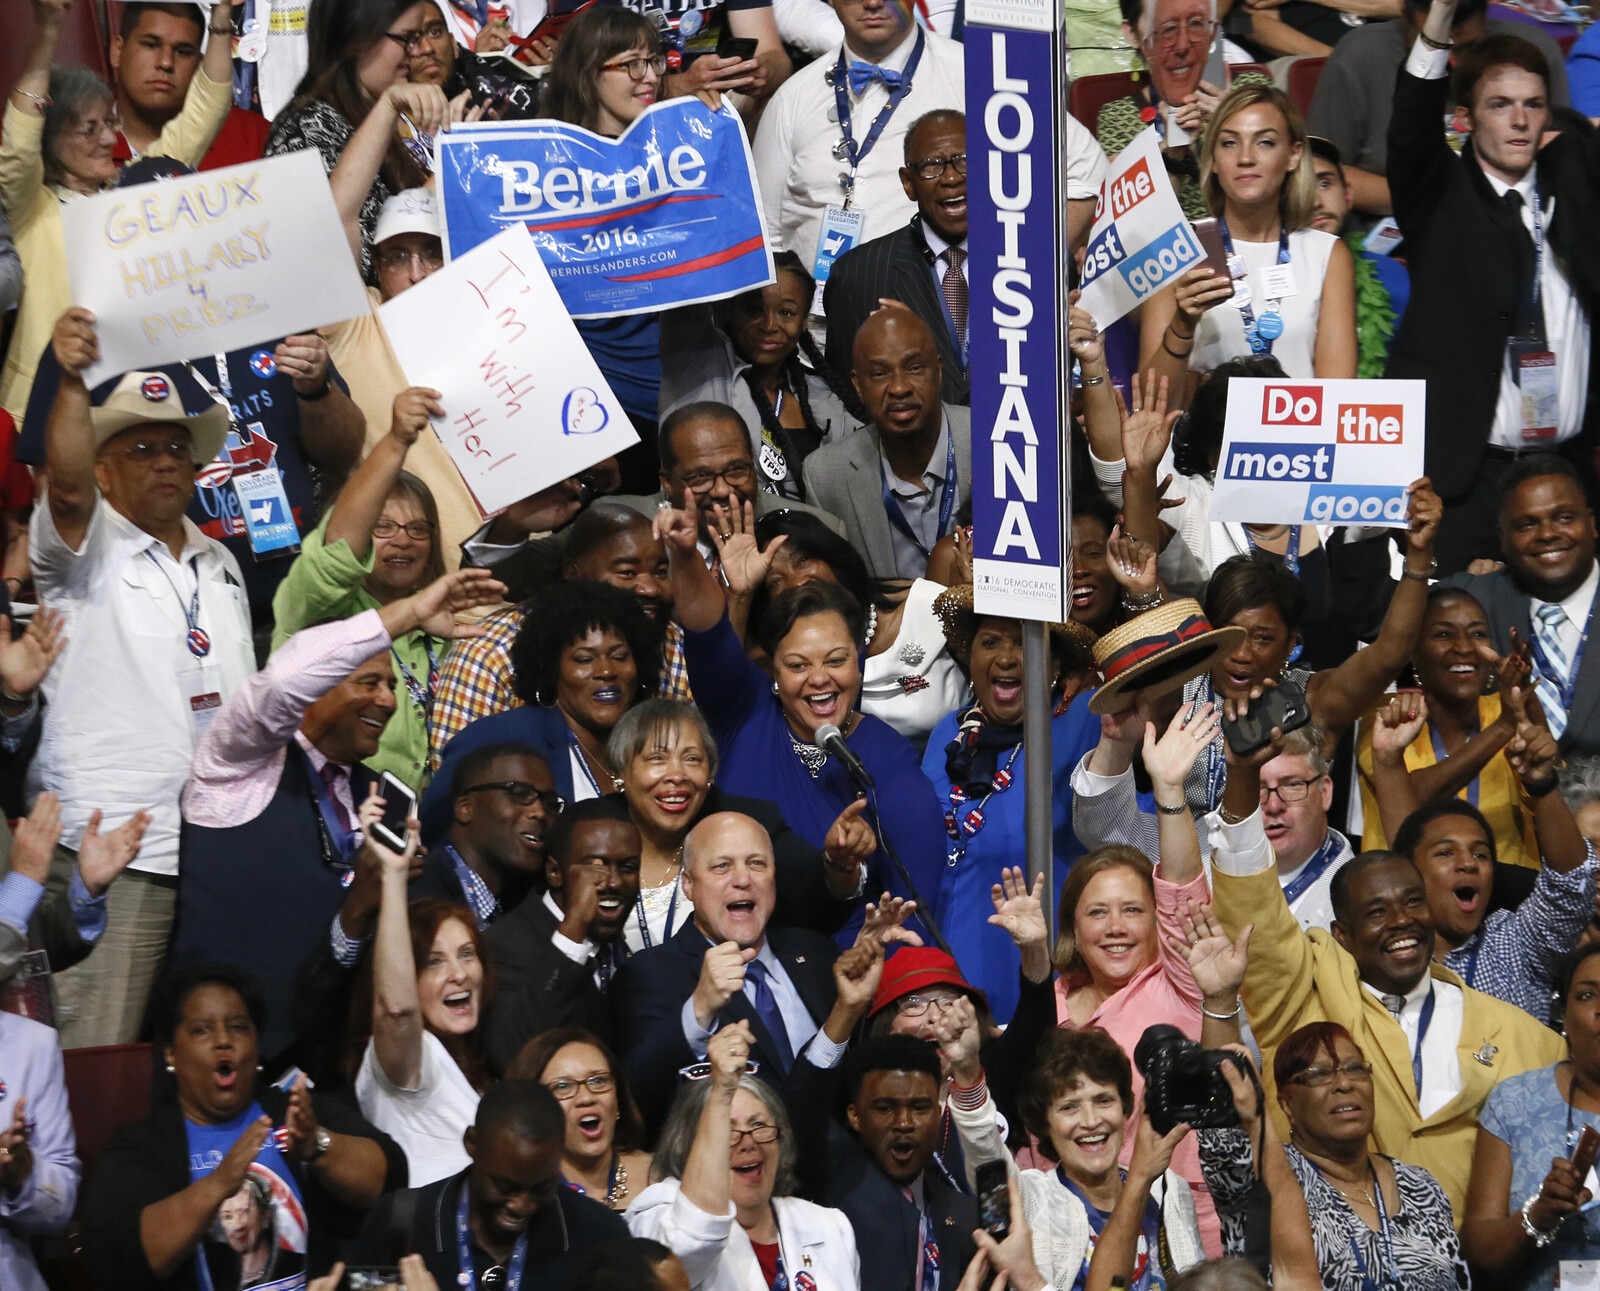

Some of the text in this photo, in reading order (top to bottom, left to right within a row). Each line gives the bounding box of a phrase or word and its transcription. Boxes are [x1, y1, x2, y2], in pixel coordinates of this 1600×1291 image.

[498, 142, 708, 213] Bernie
[1112, 171, 1151, 215] the
[105, 171, 267, 249] GEAUX
[827, 215, 859, 225] DELEGATION
[828, 208, 860, 219] COLORADO
[582, 226, 638, 253] 2016
[119, 220, 272, 298] HILLARY
[551, 250, 678, 278] BERNIESANDERS.COM
[1128, 227, 1195, 294] good
[187, 279, 211, 301] 4
[466, 250, 532, 344] I'm
[983, 32, 1042, 560] LOUISIANA
[139, 294, 269, 344] PREZ
[1267, 388, 1401, 442] Do the
[763, 456, 780, 476] TPP
[1229, 446, 1329, 480] most
[1310, 490, 1409, 522] good
[977, 585, 1057, 599] NATIONAL CONVENTION
[1004, 578, 1057, 592] DEMOCRATIC
